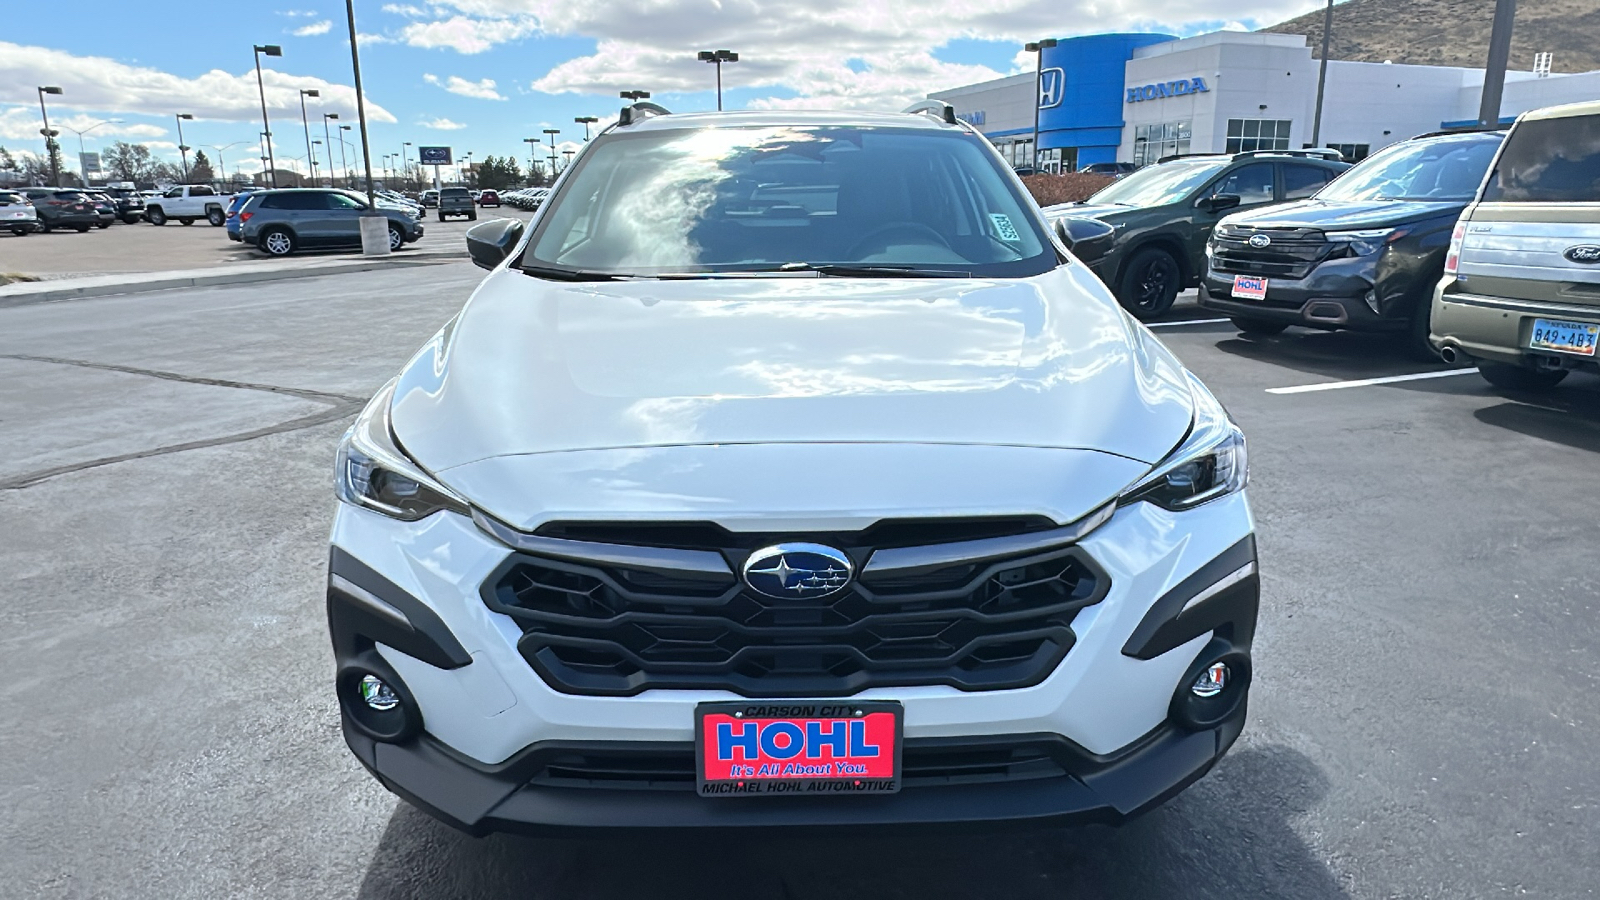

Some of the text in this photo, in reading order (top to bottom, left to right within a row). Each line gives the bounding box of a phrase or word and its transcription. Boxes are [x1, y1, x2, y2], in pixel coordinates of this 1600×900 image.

[1126, 77, 1210, 103] HONDA
[1572, 248, 1600, 259] Ford
[1238, 280, 1262, 290] HOHL
[744, 705, 858, 717] CARSON CITY
[717, 720, 880, 760] HOHL
[730, 761, 868, 777] It's All About You.
[702, 780, 897, 794] MICHAEL HOHL AUTOMOTIVE
